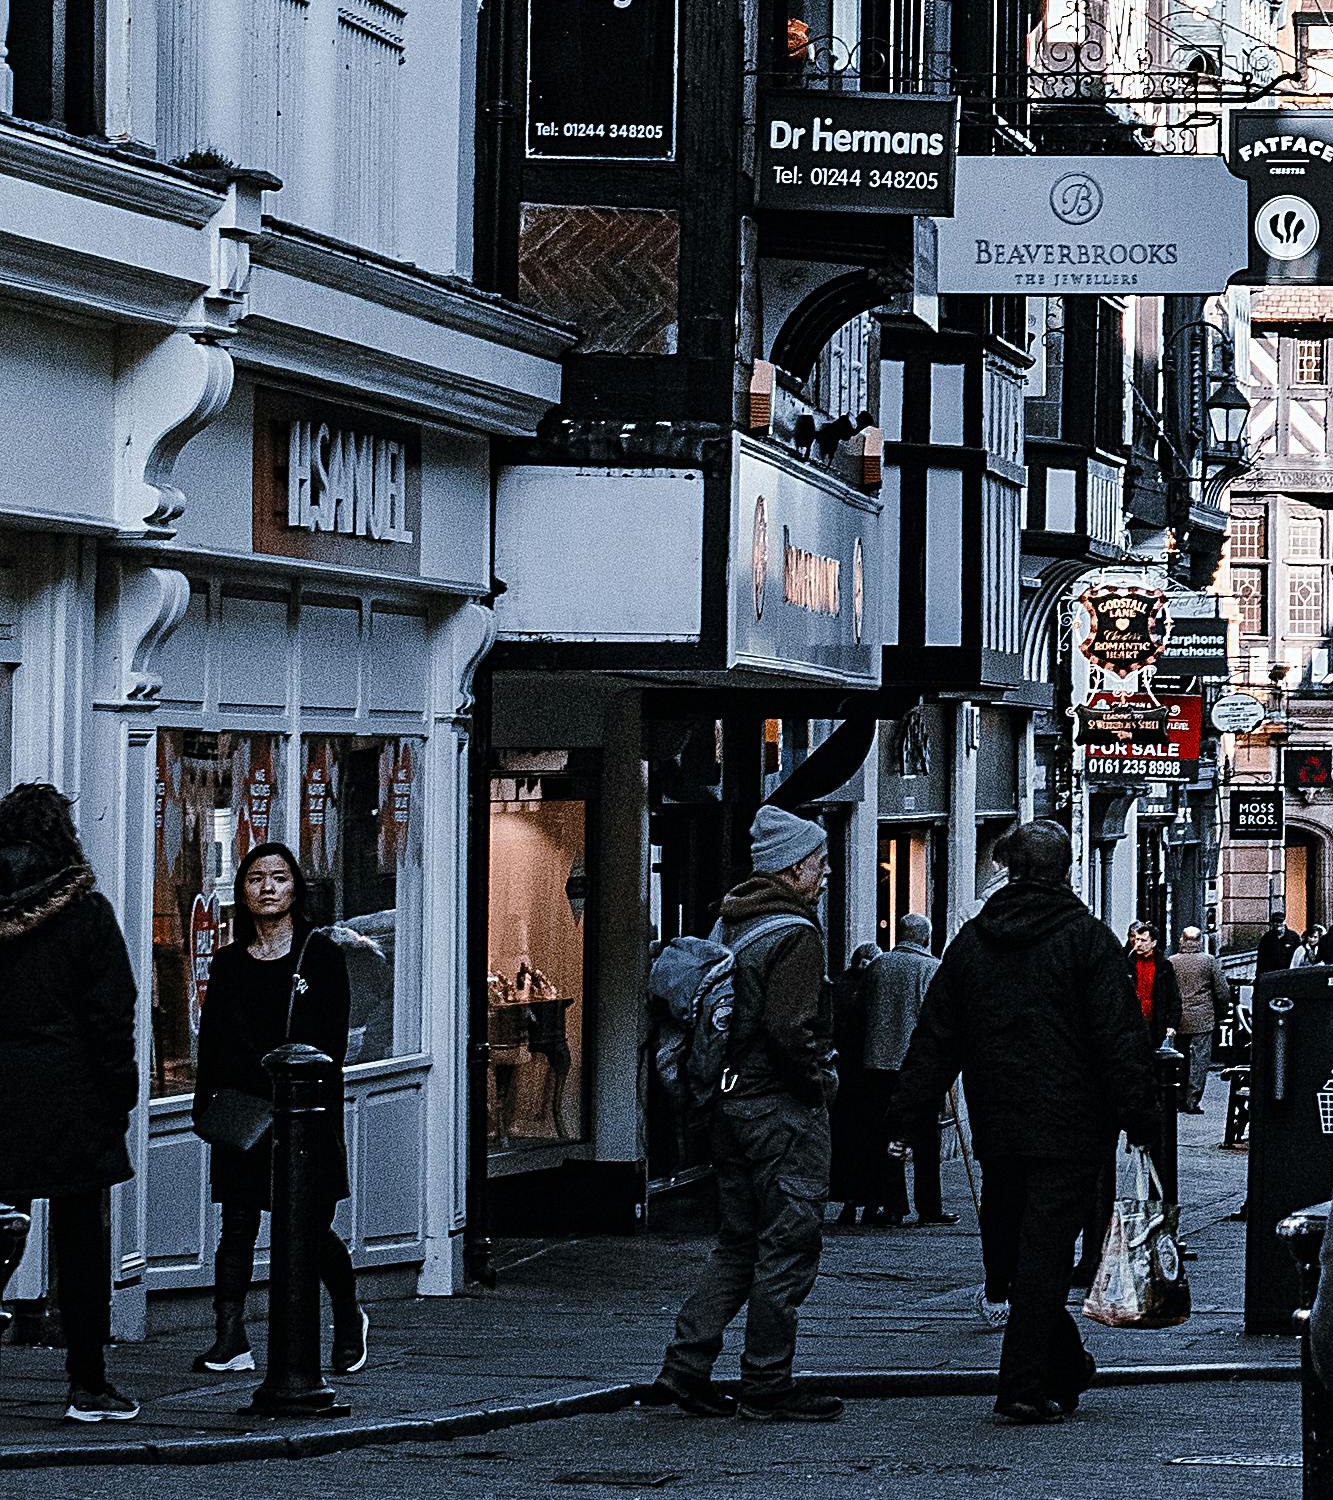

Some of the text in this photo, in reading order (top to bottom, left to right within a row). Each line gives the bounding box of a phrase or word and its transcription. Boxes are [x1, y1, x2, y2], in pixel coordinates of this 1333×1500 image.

[536, 122, 663, 139] Tel: 01244 348205
[770, 120, 806, 149] Dr
[773, 165, 939, 190] Tel: 01244 348205
[1015, 273, 1138, 286] THE JEWELLERS
[1097, 598, 1148, 614] GODSTALL
[1109, 609, 1137, 618] LANE
[1094, 642, 1150, 651] ROMANTIC
[1106, 650, 1139, 659] HEART
[1132, 743, 1180, 756] SALE
[1089, 759, 1180, 775] 0161 235 8998
[1239, 803, 1274, 813] MOSS
[1239, 814, 1278, 825] BROS.
